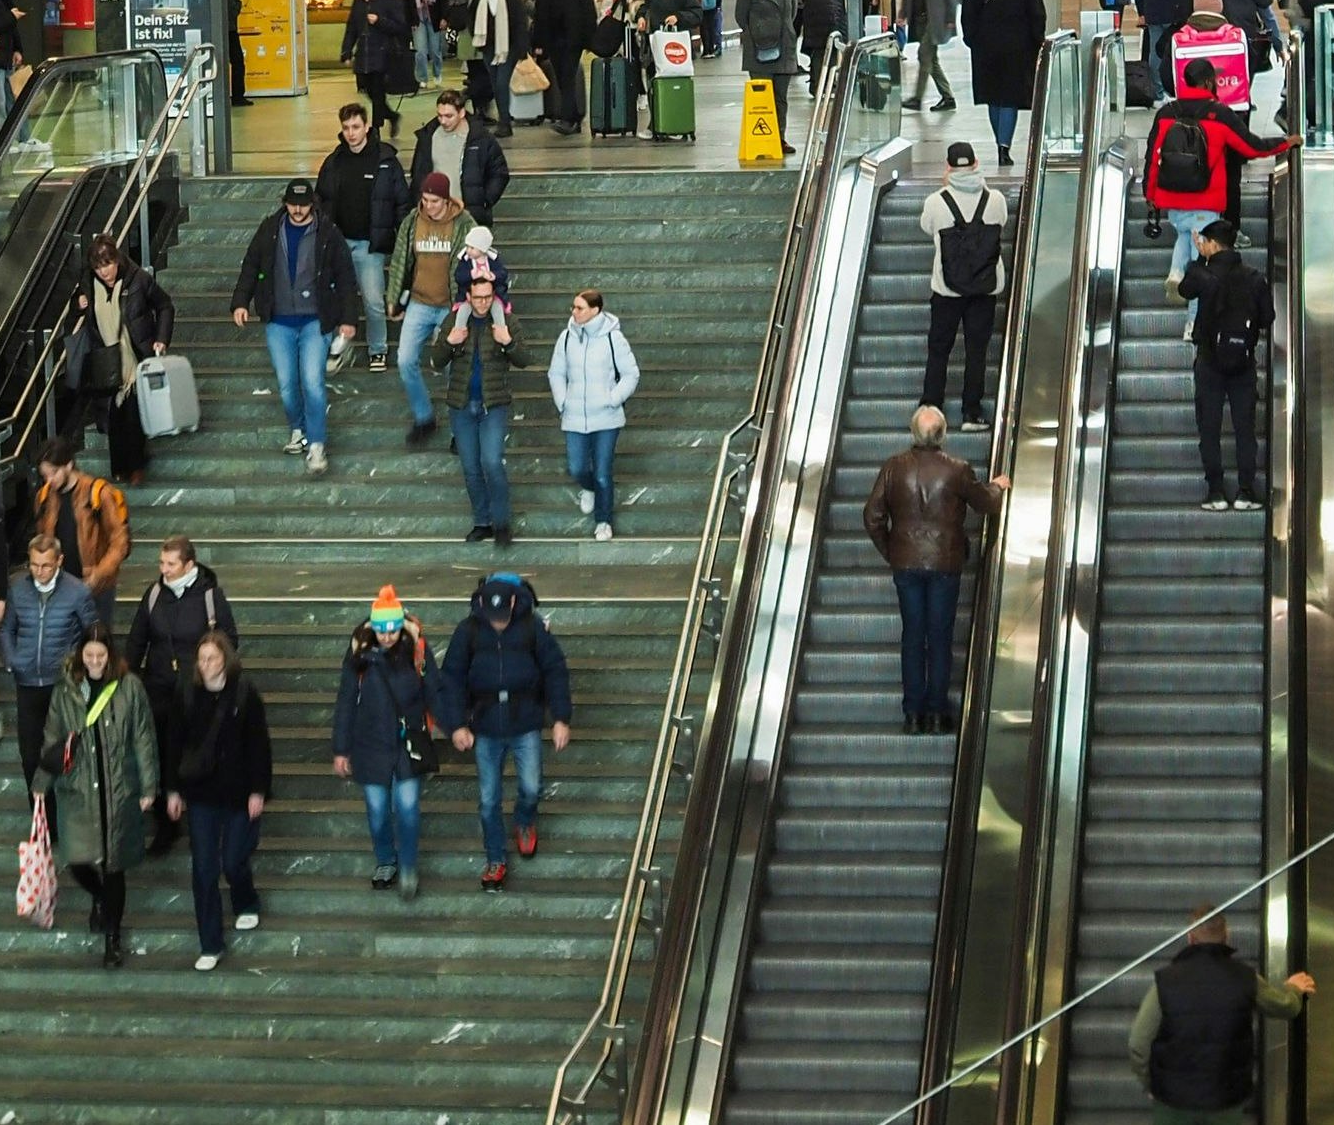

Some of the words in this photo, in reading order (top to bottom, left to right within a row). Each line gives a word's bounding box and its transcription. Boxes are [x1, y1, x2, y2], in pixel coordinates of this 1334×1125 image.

[135, 14, 163, 25] Dein
[166, 14, 189, 25] Sitz
[135, 28, 151, 39] ist
[153, 28, 173, 39] fix!
[1217, 76, 1238, 87] ora
